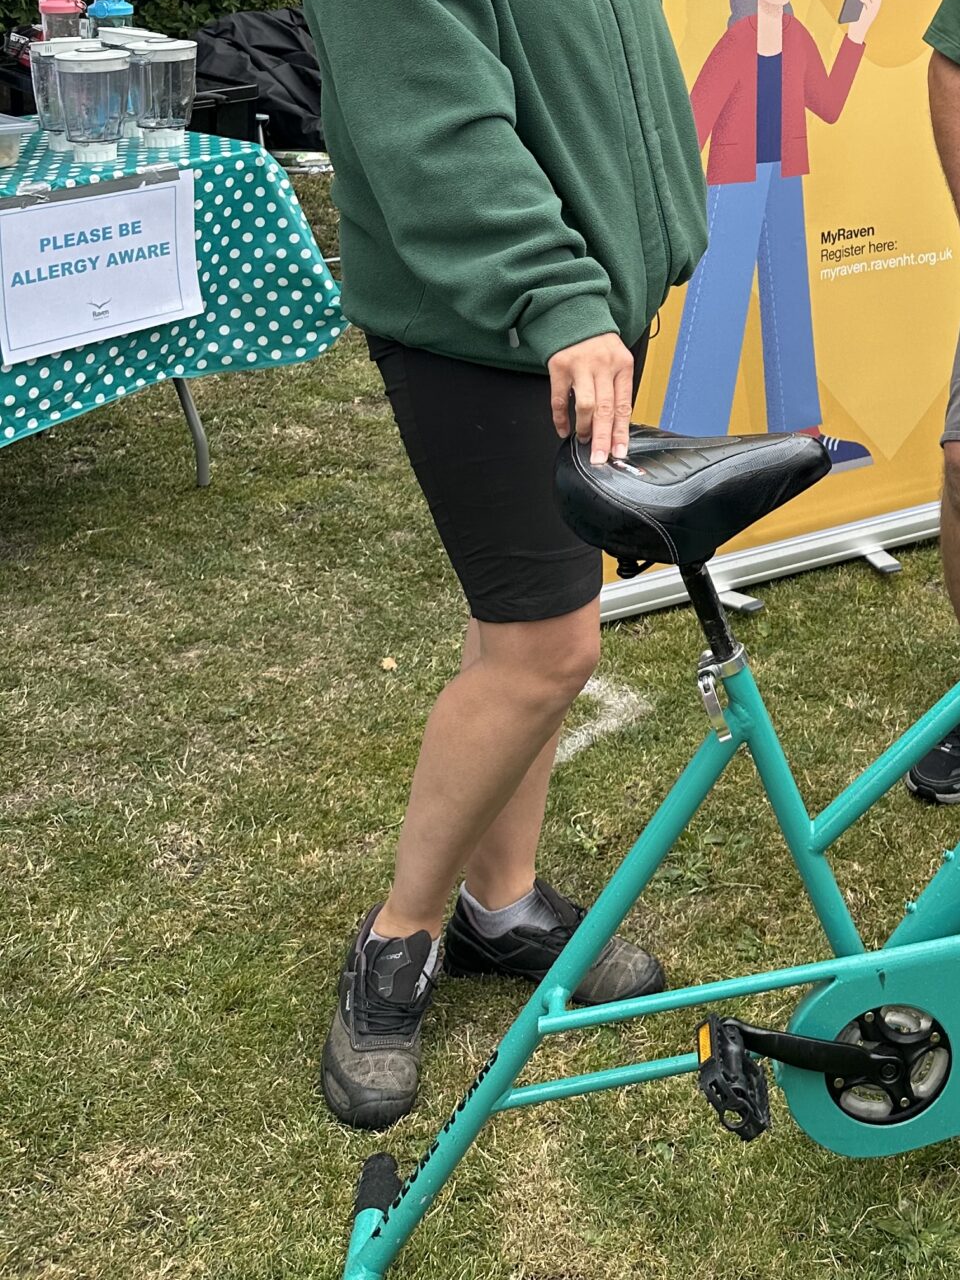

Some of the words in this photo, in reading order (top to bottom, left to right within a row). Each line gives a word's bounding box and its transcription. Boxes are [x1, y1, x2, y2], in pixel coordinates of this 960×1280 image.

[39, 226, 113, 253] PLEASE
[118, 220, 142, 238] BE
[820, 226, 875, 245] MyRaven
[820, 244, 866, 262] Register
[868, 240, 898, 254] here:
[11, 255, 100, 288] ALLERGY
[106, 241, 171, 268] AWARE
[820, 248, 953, 281] myraven.ravenht.org.uk
